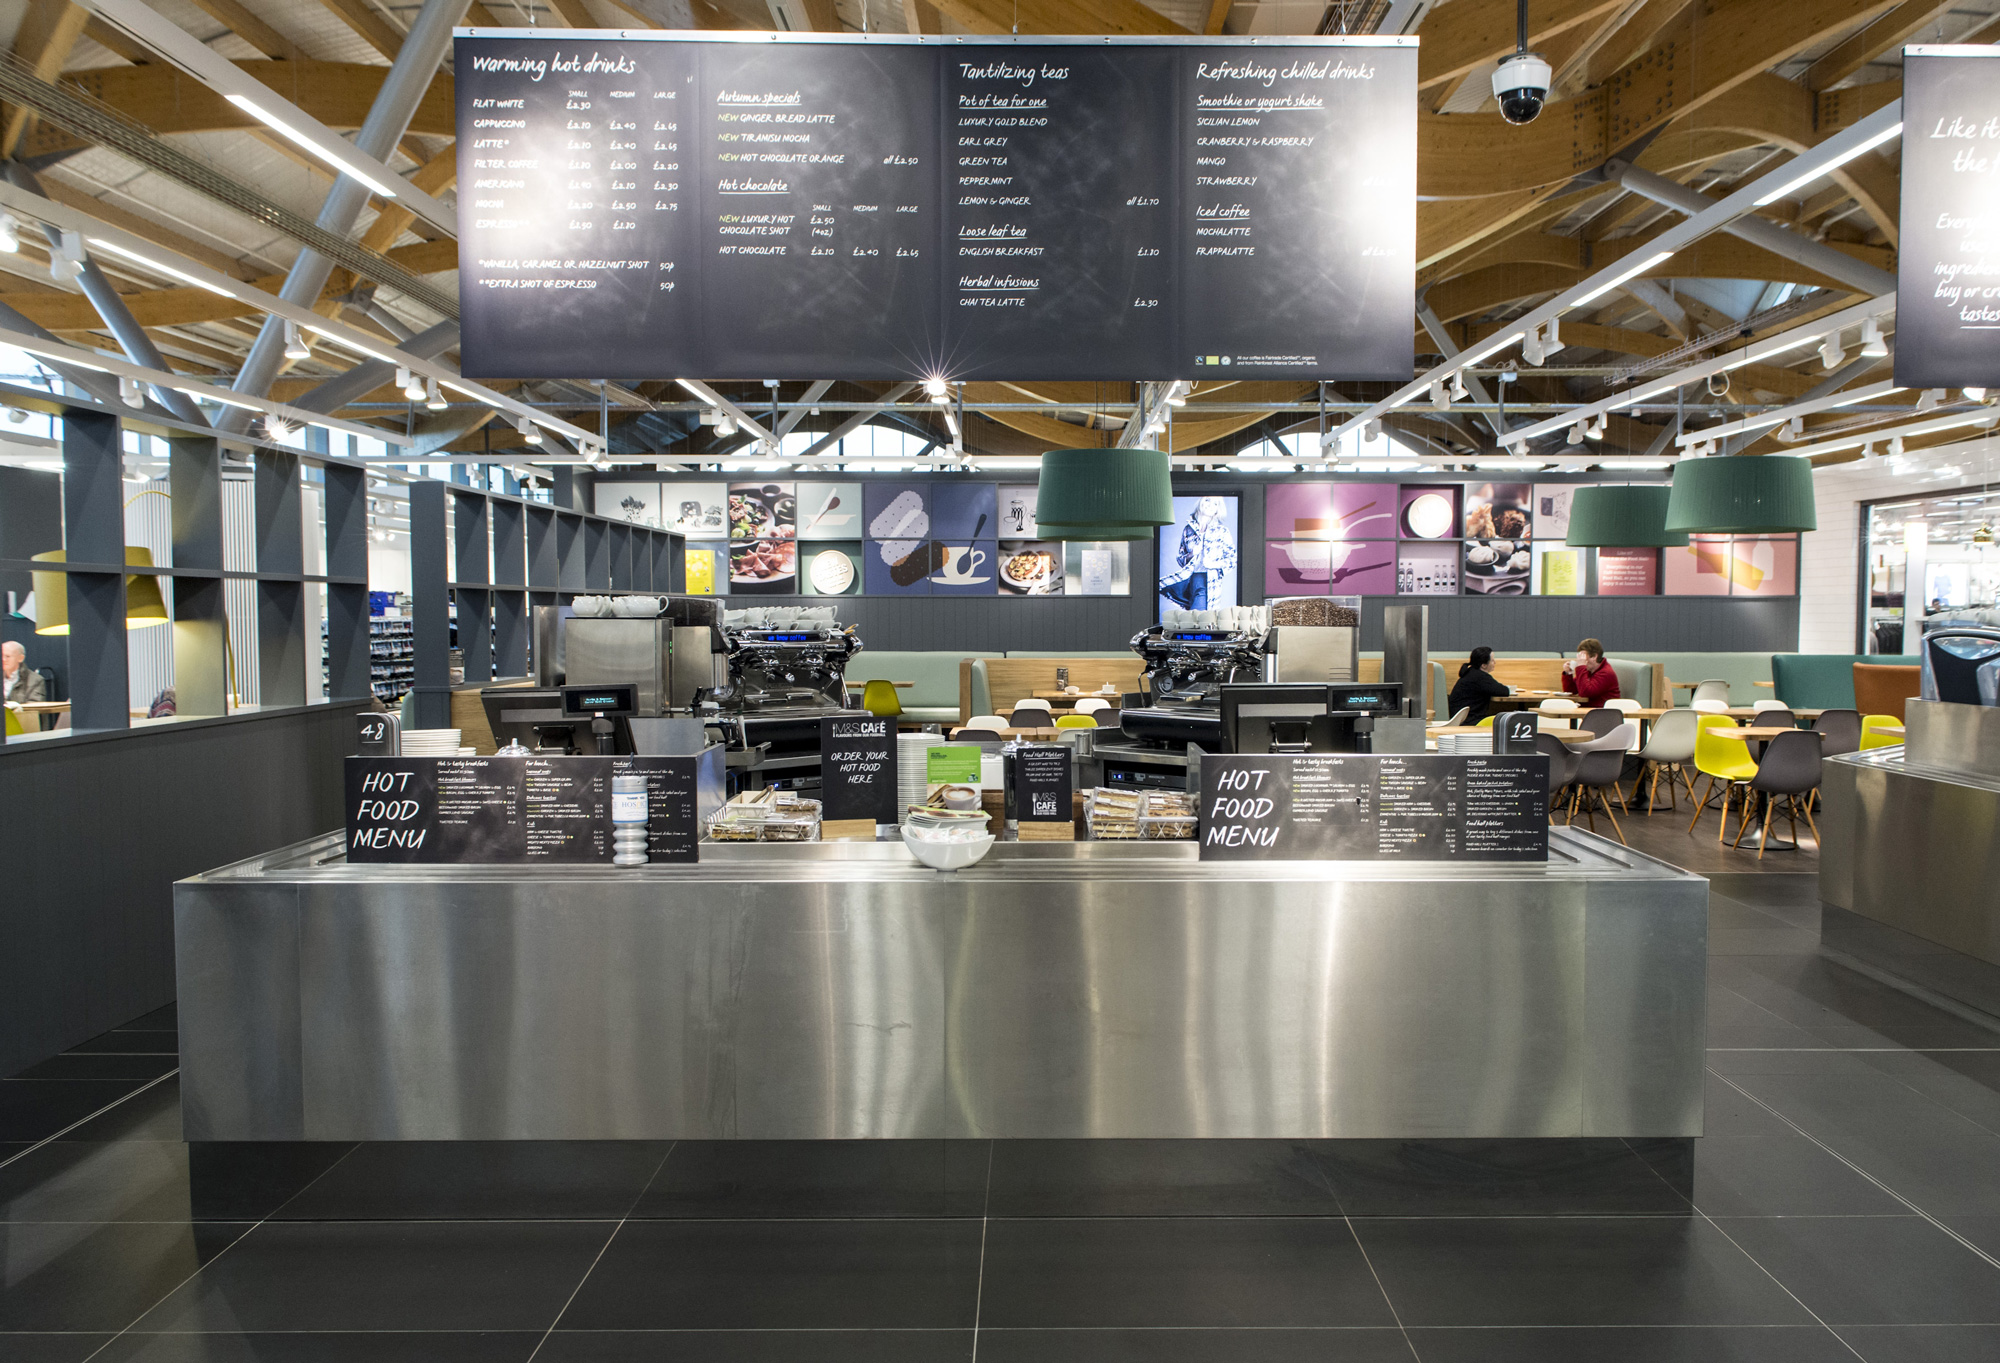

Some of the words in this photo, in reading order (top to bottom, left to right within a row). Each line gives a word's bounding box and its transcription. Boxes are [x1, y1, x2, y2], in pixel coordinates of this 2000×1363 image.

[473, 56, 547, 82] Warming
[551, 51, 581, 73] hot
[583, 52, 636, 75] drinks
[960, 62, 1036, 87] Tantilizing
[1041, 63, 1070, 80] teas
[1196, 61, 1277, 87] Refreshing
[1281, 60, 1330, 80] chilled
[1329, 62, 1376, 80] drinks
[653, 91, 677, 99] LARGE
[717, 90, 762, 103] Autumn
[762, 90, 802, 107] specials
[959, 94, 978, 106] Pot
[979, 94, 991, 108] of
[992, 95, 1008, 107] tea
[1010, 93, 1027, 107] for
[1028, 99, 1047, 107] one
[472, 99, 496, 108] FLAT
[496, 99, 525, 108] WHITE
[1197, 94, 1243, 107] Smoothie
[1244, 98, 1256, 107] or
[1257, 96, 1293, 112] yogurt
[1294, 94, 1323, 107] shake
[473, 119, 526, 128] CAPPUCCINO
[718, 114, 739, 122] NEW
[740, 114, 773, 123] GINGER
[774, 114, 805, 123] BREAD
[806, 114, 836, 124] LATTE
[958, 117, 994, 127] LUXURY
[995, 117, 1017, 127] GOLD
[1019, 117, 1048, 127] BLEND
[1197, 117, 1230, 127] SICILIAN
[1231, 117, 1260, 127] LEMON
[1930, 116, 1977, 139] Like
[718, 133, 739, 142] NEW
[740, 133, 781, 143] TIRAMISU
[782, 134, 810, 143] MOCHA
[959, 137, 982, 146] EARL
[983, 137, 1008, 146] GREY
[1197, 137, 1252, 147] CRANBERRY
[1261, 137, 1314, 147] RASPBERRY
[474, 159, 505, 169] FILTER
[508, 159, 538, 169] COFFEE
[718, 153, 740, 162] NEW
[740, 153, 758, 162] HOT
[759, 154, 808, 163] CHOCOLATE
[809, 154, 845, 164] ORANGE
[883, 155, 894, 165] all
[894, 157, 919, 166] £2.50
[959, 157, 990, 166] GREEN
[991, 157, 1008, 166] TEA
[1196, 157, 1226, 166] MANGO
[1952, 146, 1988, 172] the
[718, 179, 738, 191] Hot
[740, 177, 788, 192] chocolate
[959, 177, 1013, 186] PEPPERMINT
[1196, 176, 1257, 186] STRAWBERRY
[959, 196, 989, 205] LEMON
[990, 197, 998, 205] &
[999, 197, 1031, 206] GINGER
[1126, 196, 1137, 206] all
[1137, 197, 1159, 206] £1.70
[1196, 203, 1219, 217] Iced
[1219, 204, 1250, 218] coffee
[719, 215, 741, 223] NEW
[741, 215, 777, 224] LUXURY
[777, 215, 796, 224] HOT
[810, 216, 835, 225] £2.50
[719, 226, 768, 235] CHOCOLATE
[769, 226, 791, 235] SHOT
[811, 227, 834, 237] (4oz)
[959, 225, 987, 237] Loose
[988, 224, 1010, 238] leaf
[1011, 225, 1027, 237] tea
[1196, 227, 1251, 236] MOCHALATTE
[719, 246, 737, 255] HOT
[738, 246, 787, 255] CHOCOLATE
[853, 248, 879, 256] £2.40
[895, 248, 919, 258] £2.65
[959, 247, 994, 256] ENGLISH
[995, 247, 1044, 256] BREAKFAST
[1196, 247, 1255, 256] FRAPPALATTE
[521, 259, 562, 269] CARAMEL
[564, 260, 577, 269] OR
[578, 260, 625, 269] HAZELNUT
[627, 260, 650, 270] SHOT
[660, 262, 674, 273] 50p
[519, 280, 541, 289] SHOT
[543, 280, 554, 289] OF
[555, 280, 597, 289] ESPRESSO
[660, 281, 675, 293] 50p
[959, 275, 994, 288] Herbal
[994, 274, 1040, 289] infusions
[1934, 278, 1962, 307] buy
[1963, 287, 1981, 298] or
[960, 298, 978, 307] CHAI
[980, 298, 996, 307] TEA
[997, 298, 1026, 307] LATTE
[1134, 299, 1158, 307] £2.30
[361, 723, 384, 740] 48
[836, 723, 859, 733] M&S
[861, 720, 886, 733] CAFÉ
[1511, 722, 1532, 738] 12
[831, 752, 863, 761] ORDER
[866, 751, 889, 761] YOUR
[840, 763, 858, 772] HOT
[859, 763, 880, 771] FOOD
[362, 772, 414, 793] HOT
[848, 775, 873, 783] HERE
[1218, 770, 1270, 790] HOT
[1037, 792, 1056, 801] M&S
[357, 799, 419, 821] FOOD
[1212, 797, 1273, 819] FOOD
[353, 827, 426, 849] MENU
[1206, 825, 1279, 847] MENU
